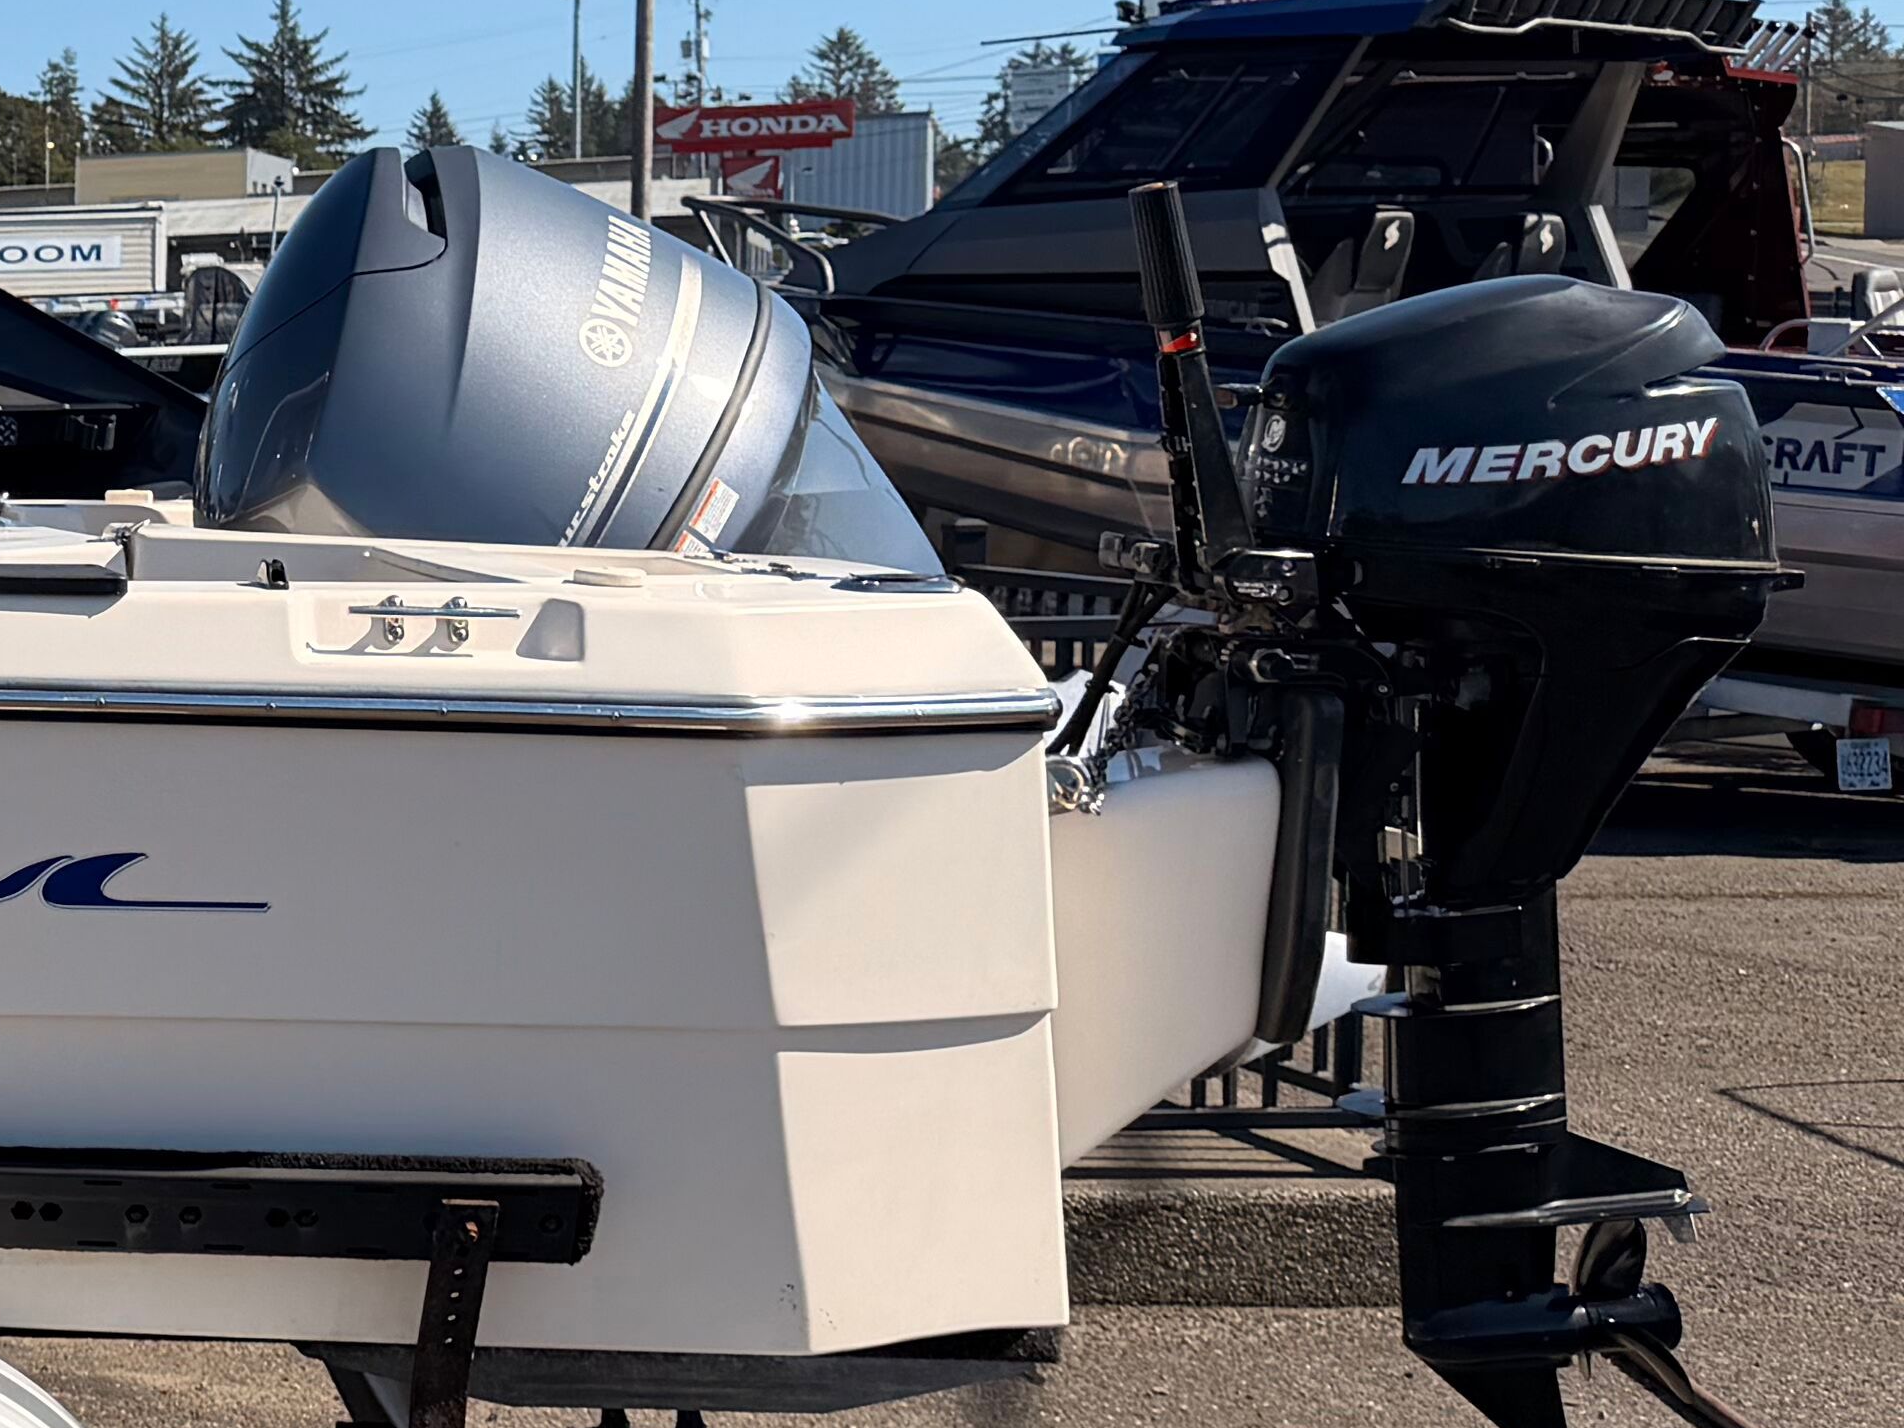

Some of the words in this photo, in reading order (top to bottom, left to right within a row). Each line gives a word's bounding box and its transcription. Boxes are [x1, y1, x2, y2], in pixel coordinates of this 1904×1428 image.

[700, 114, 848, 138] HONDA
[592, 216, 651, 327] YAMAHA
[1401, 418, 1718, 485] MERCURY
